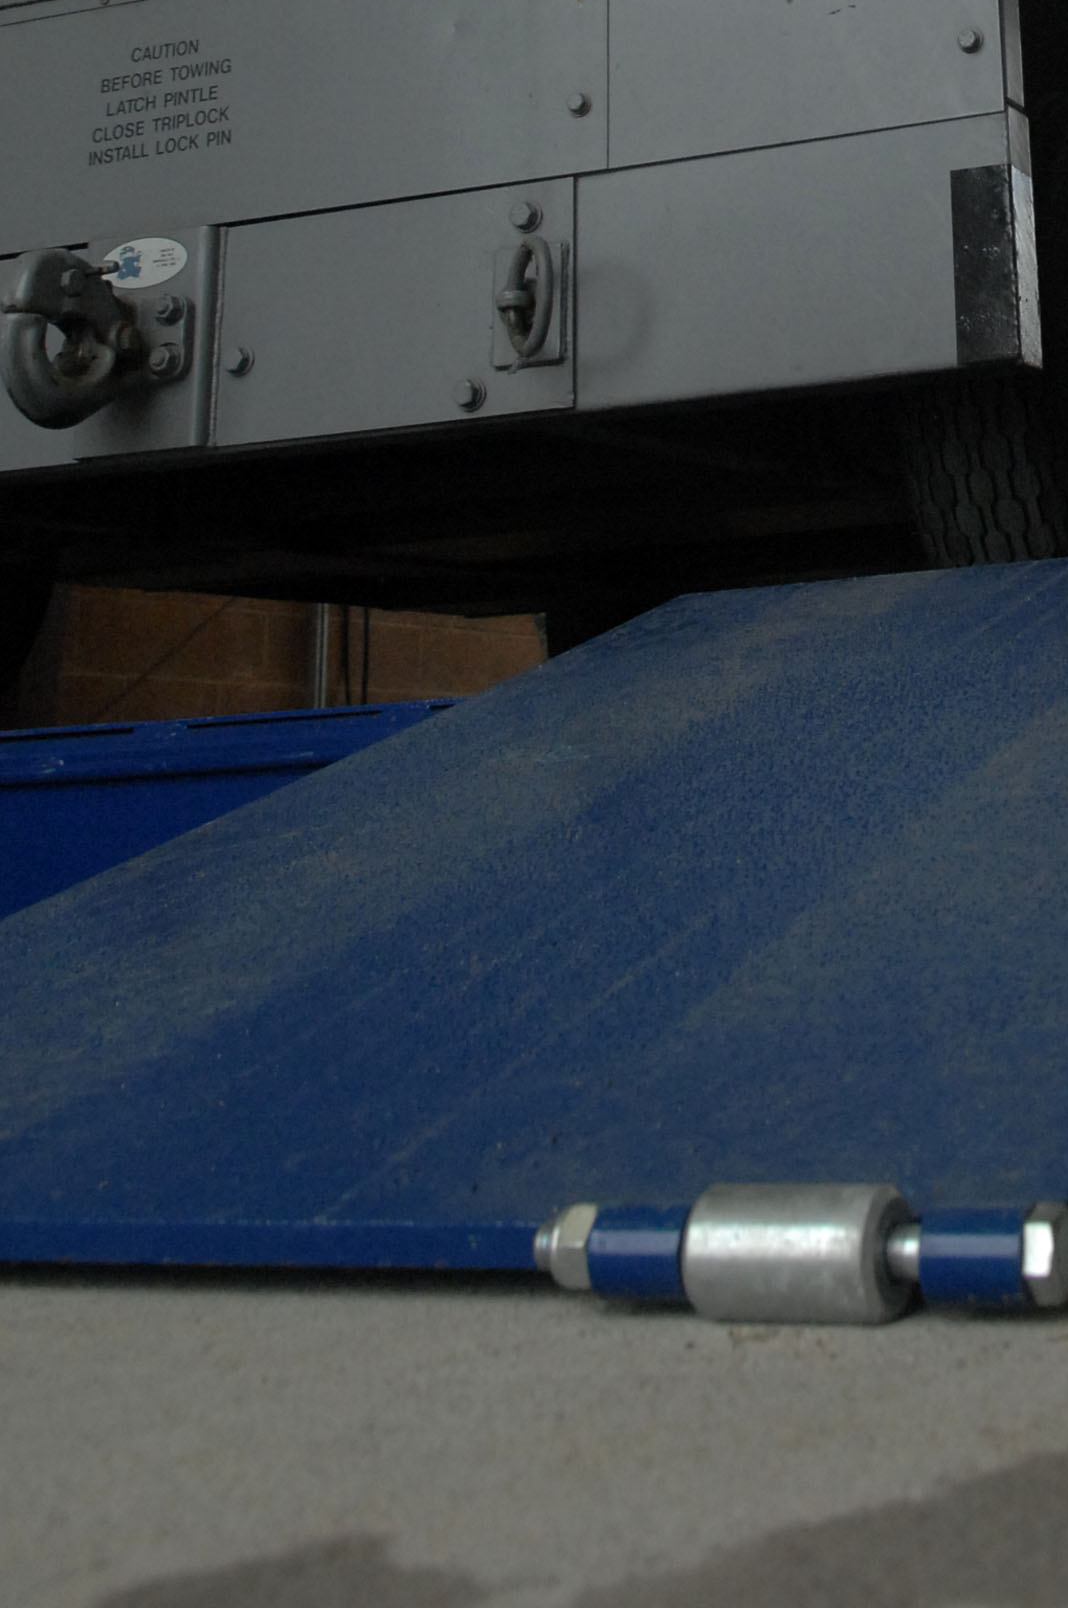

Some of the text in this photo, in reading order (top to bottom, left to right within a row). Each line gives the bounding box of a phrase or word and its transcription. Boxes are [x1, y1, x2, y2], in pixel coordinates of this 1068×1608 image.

[130, 40, 199, 63] CAUTION
[101, 59, 232, 93] BEFORE TOWING
[106, 85, 219, 117] LATCH PINTLE
[92, 106, 230, 143] CLOSE TRIPLOCK
[88, 130, 232, 166] INSTALL LOCK PIN
